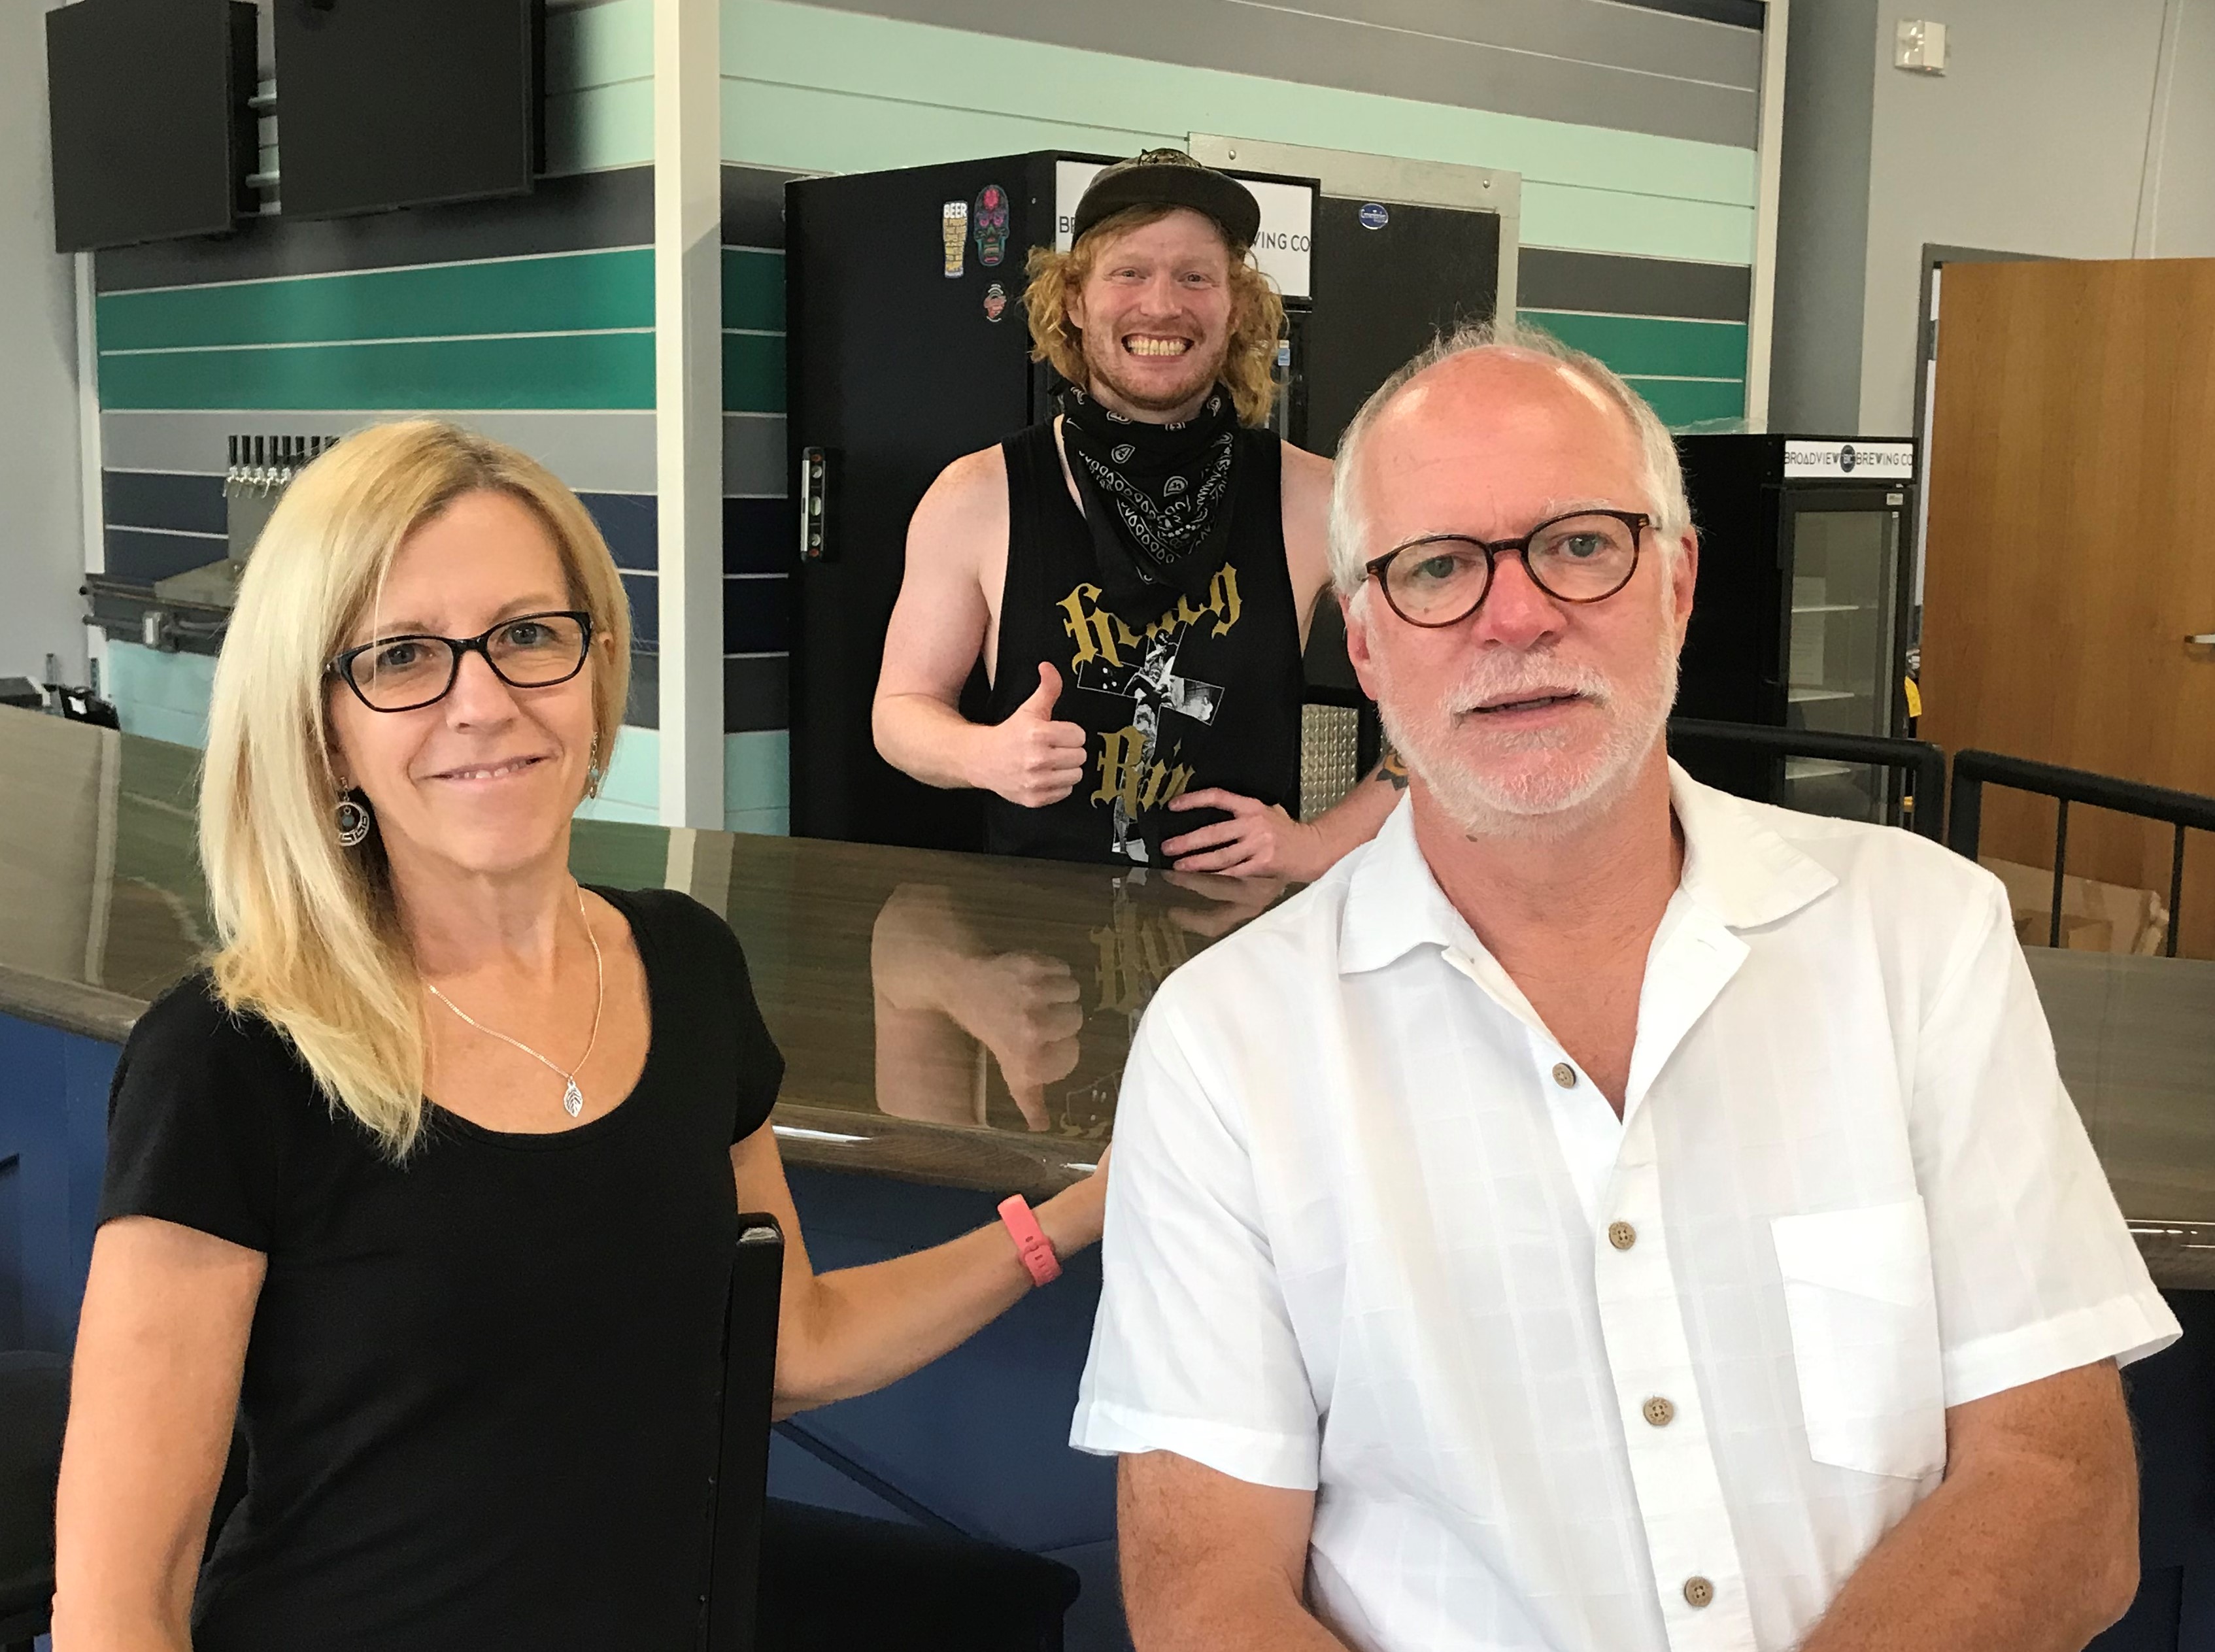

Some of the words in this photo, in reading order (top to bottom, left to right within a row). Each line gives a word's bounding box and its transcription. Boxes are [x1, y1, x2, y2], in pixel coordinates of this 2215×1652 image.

[943, 203, 967, 218] BEER
[1291, 234, 1311, 252] CO
[1784, 452, 1840, 465] BROADVIEW
[1856, 452, 1899, 465] BREWING
